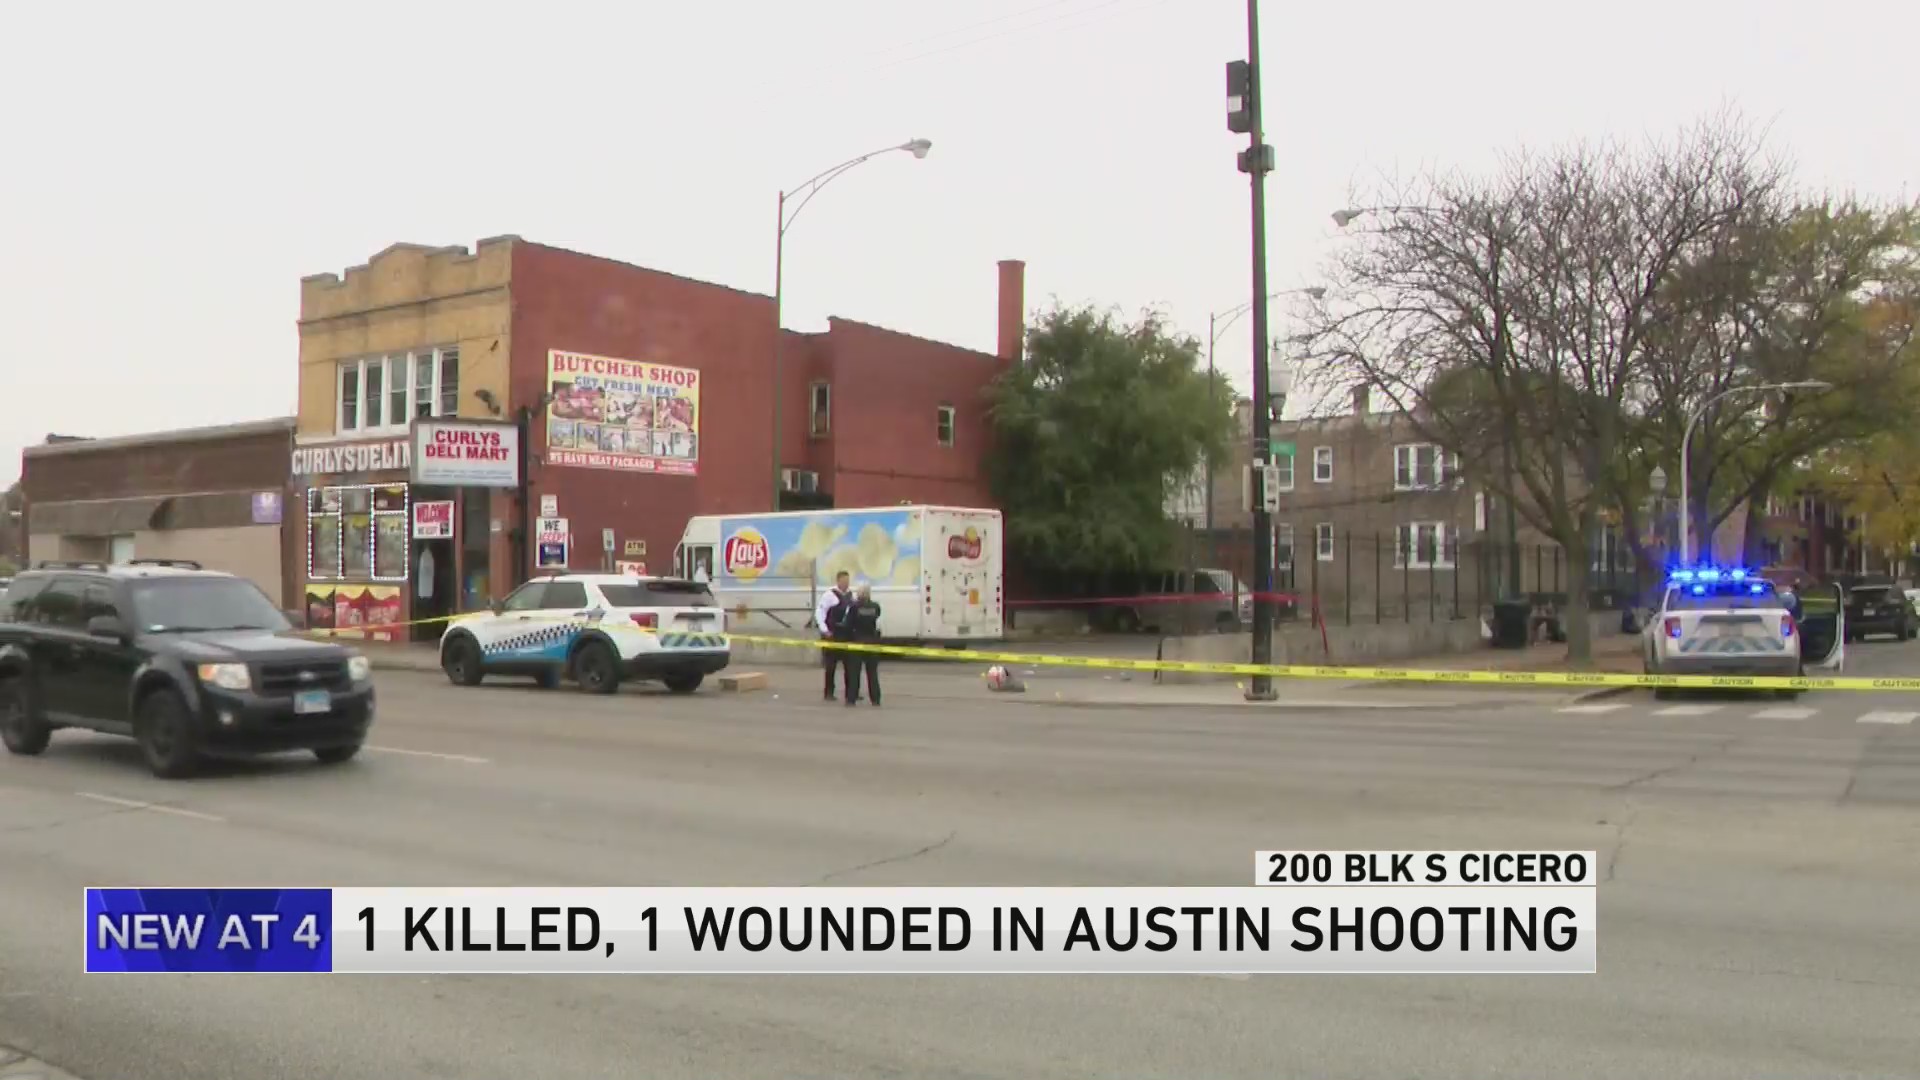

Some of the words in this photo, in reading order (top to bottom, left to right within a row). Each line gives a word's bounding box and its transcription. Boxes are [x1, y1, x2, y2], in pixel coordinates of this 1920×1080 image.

[553, 354, 644, 378] BUTCHER
[649, 367, 696, 388] SHOP
[604, 379, 642, 393] FRESH
[647, 385, 677, 397] MEAT
[435, 430, 501, 446] CURLYS
[425, 444, 461, 458] DELI
[466, 446, 509, 461] MART
[564, 452, 587, 465] HAVE
[588, 455, 612, 466] MEAT
[544, 520, 561, 531] WE
[1711, 677, 1754, 686] CAUTION
